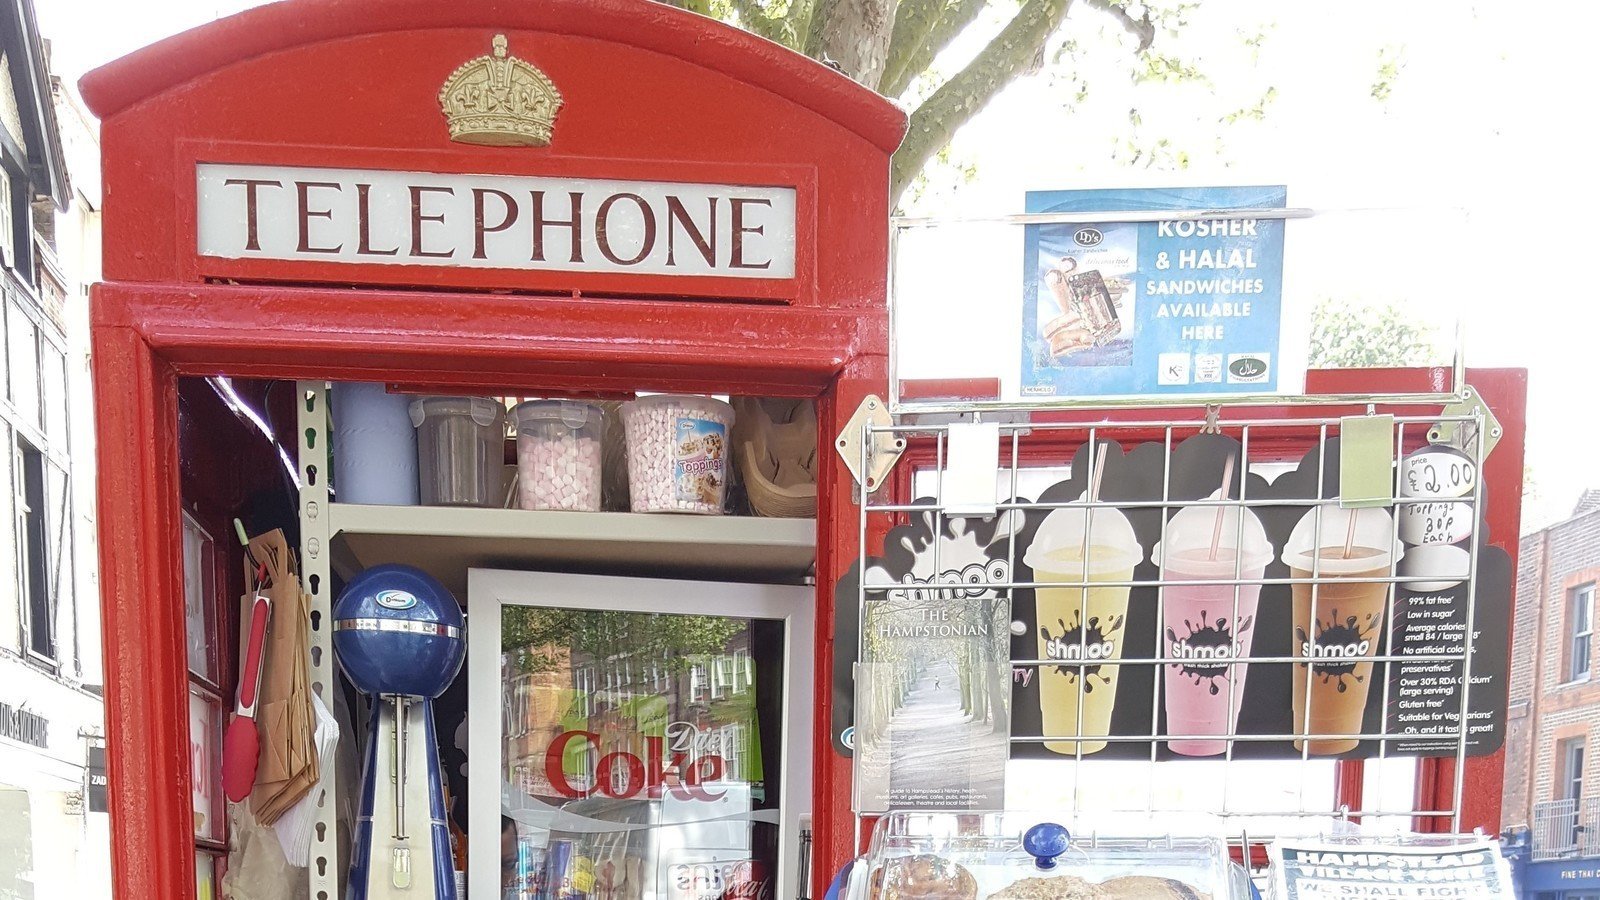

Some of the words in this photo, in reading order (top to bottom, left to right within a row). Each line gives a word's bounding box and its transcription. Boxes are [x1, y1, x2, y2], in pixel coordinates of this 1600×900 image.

[224, 179, 772, 269] TELEPHONE
[1158, 219, 1257, 237] KOSHER
[1156, 252, 1169, 269] &
[1179, 250, 1257, 269] HALAL
[1146, 279, 1263, 295] SANDWICHES
[1156, 303, 1250, 318] AVAILABLE
[1182, 326, 1223, 340] HERE
[679, 456, 722, 476] Toppings
[1411, 458, 1427, 467] price
[1423, 532, 1453, 543] Each
[1408, 597, 1424, 605] 99%
[1425, 597, 1436, 605] fat
[921, 609, 948, 621] THE
[1423, 610, 1430, 618] in
[880, 625, 988, 637] HAMPSTONIAN
[1406, 624, 1436, 632] Average
[1404, 632, 1424, 641] small
[1425, 632, 1435, 640] 84
[1442, 631, 1463, 642] large
[1415, 645, 1445, 654] artificial
[1446, 645, 1477, 653] colos,
[1400, 678, 1419, 686] Over
[1420, 678, 1437, 686] 30%
[1439, 677, 1456, 685] RDA
[1458, 676, 1492, 685] Clcium
[1400, 687, 1422, 697] (large
[1423, 686, 1453, 696] serving)
[1399, 700, 1425, 708] Gluten
[1398, 713, 1430, 721] Suitable
[1444, 711, 1493, 722] Vegarians
[1438, 725, 1443, 733] it
[1444, 725, 1468, 733] tasts
[1469, 724, 1493, 734] great!
[665, 721, 734, 751] Diet
[545, 730, 728, 801] Coke
[1297, 852, 1484, 869] HAMPSTEAD
[1561, 870, 1576, 879] FINE
[1579, 870, 1594, 878] THAI
[1340, 885, 1402, 897] SHALL
